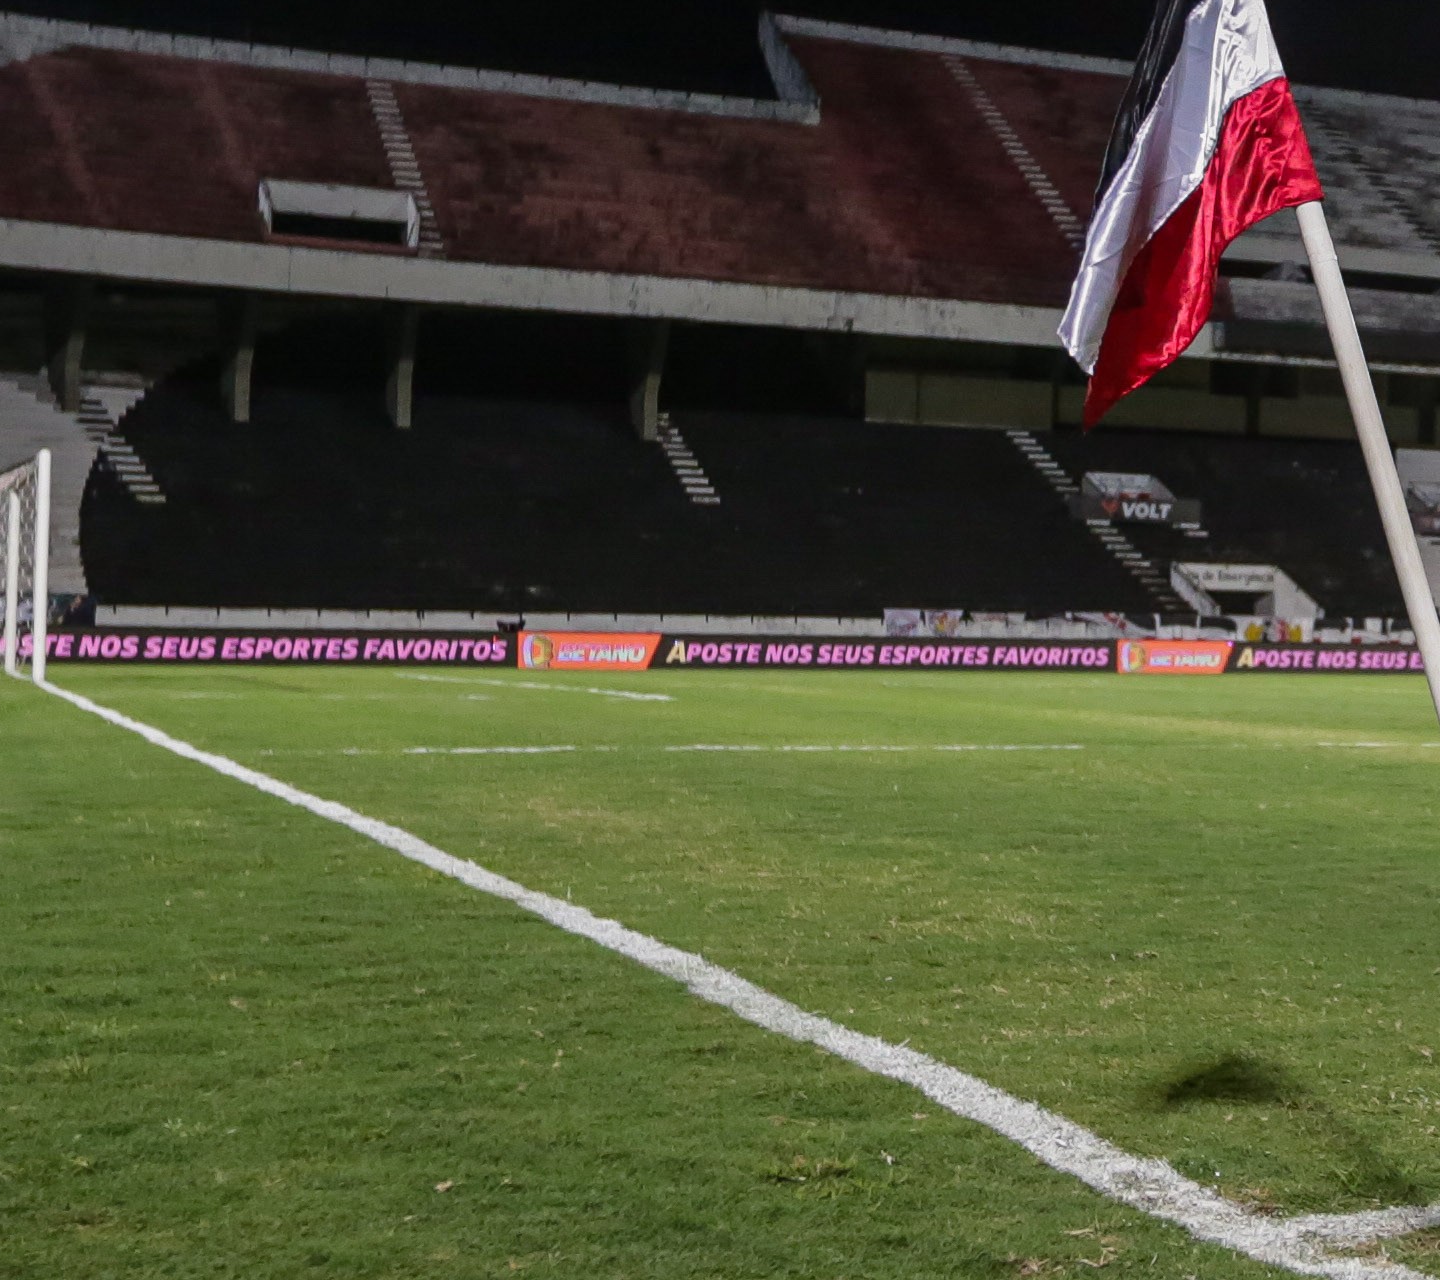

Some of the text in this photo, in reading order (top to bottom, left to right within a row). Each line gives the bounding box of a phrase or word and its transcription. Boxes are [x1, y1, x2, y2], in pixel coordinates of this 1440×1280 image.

[1122, 502, 1172, 520] VOLT
[79, 635, 139, 659] NOS
[144, 635, 216, 659] SEUS
[221, 637, 359, 661] ESPORTES
[363, 638, 507, 662] FAVORITOS
[666, 640, 1109, 666] APOSTE NOS SEUS ESPORTES FAVORITOS
[1237, 647, 1315, 669] APOSTE
[1317, 650, 1358, 669] NOS
[1360, 650, 1408, 670] SEUS
